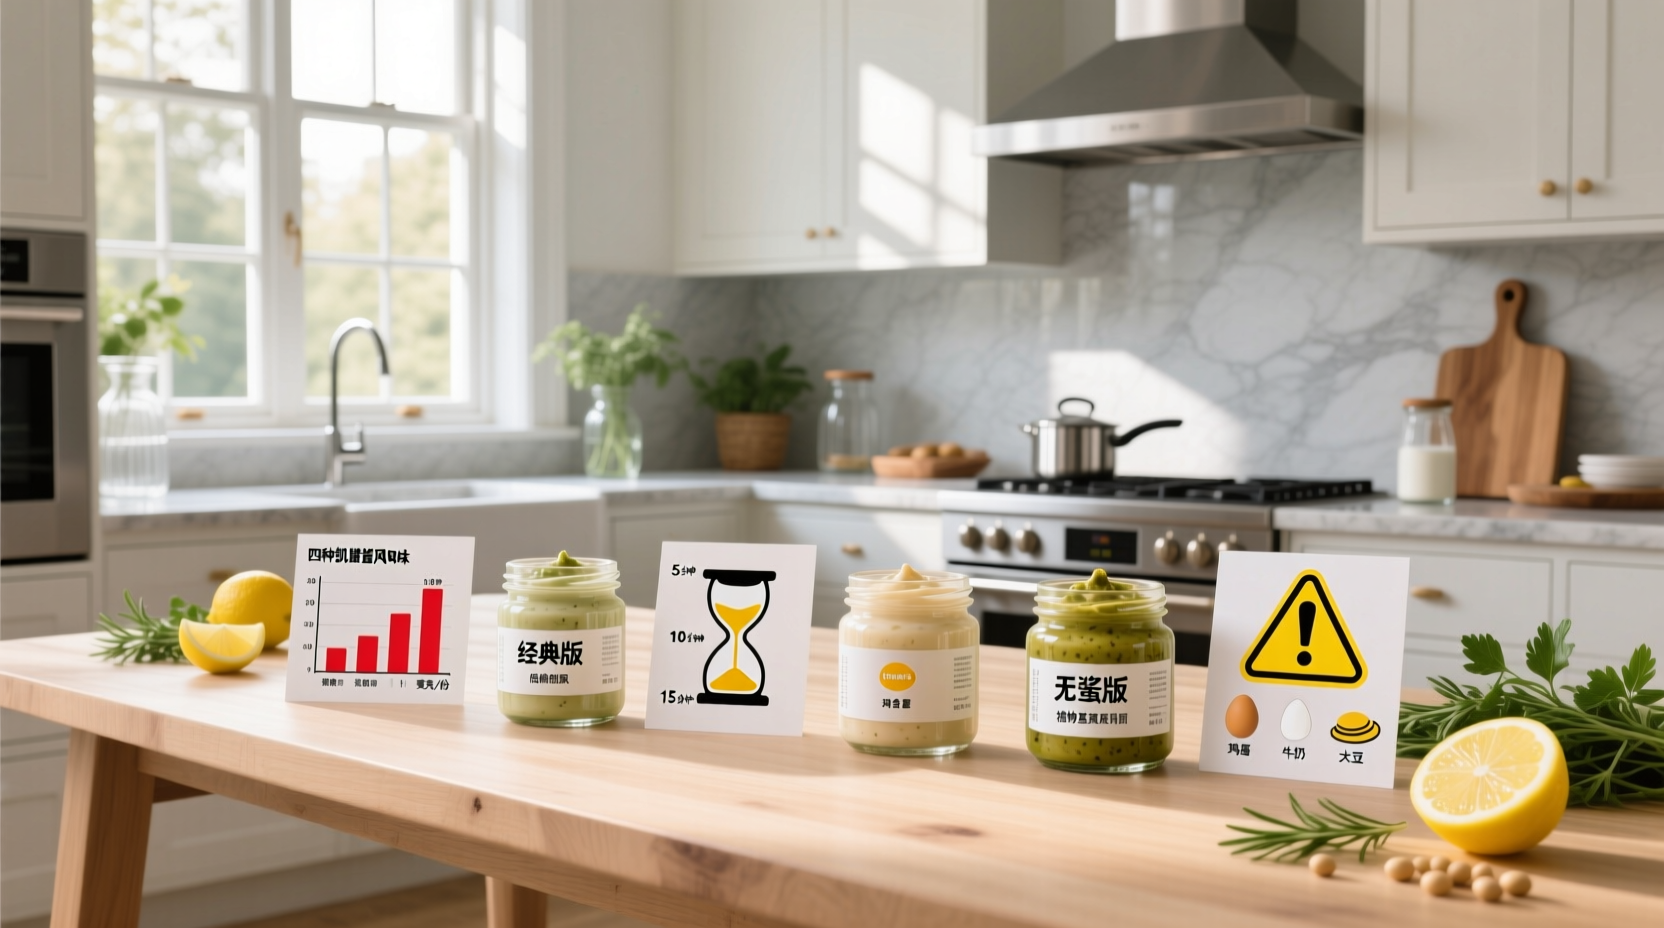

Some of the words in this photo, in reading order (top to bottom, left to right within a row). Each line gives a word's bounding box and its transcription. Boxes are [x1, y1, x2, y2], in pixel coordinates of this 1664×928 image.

[517, 640, 583, 665] 经典版
[1282, 746, 1306, 760] 牛奶
[1339, 750, 1364, 764] 大豆
